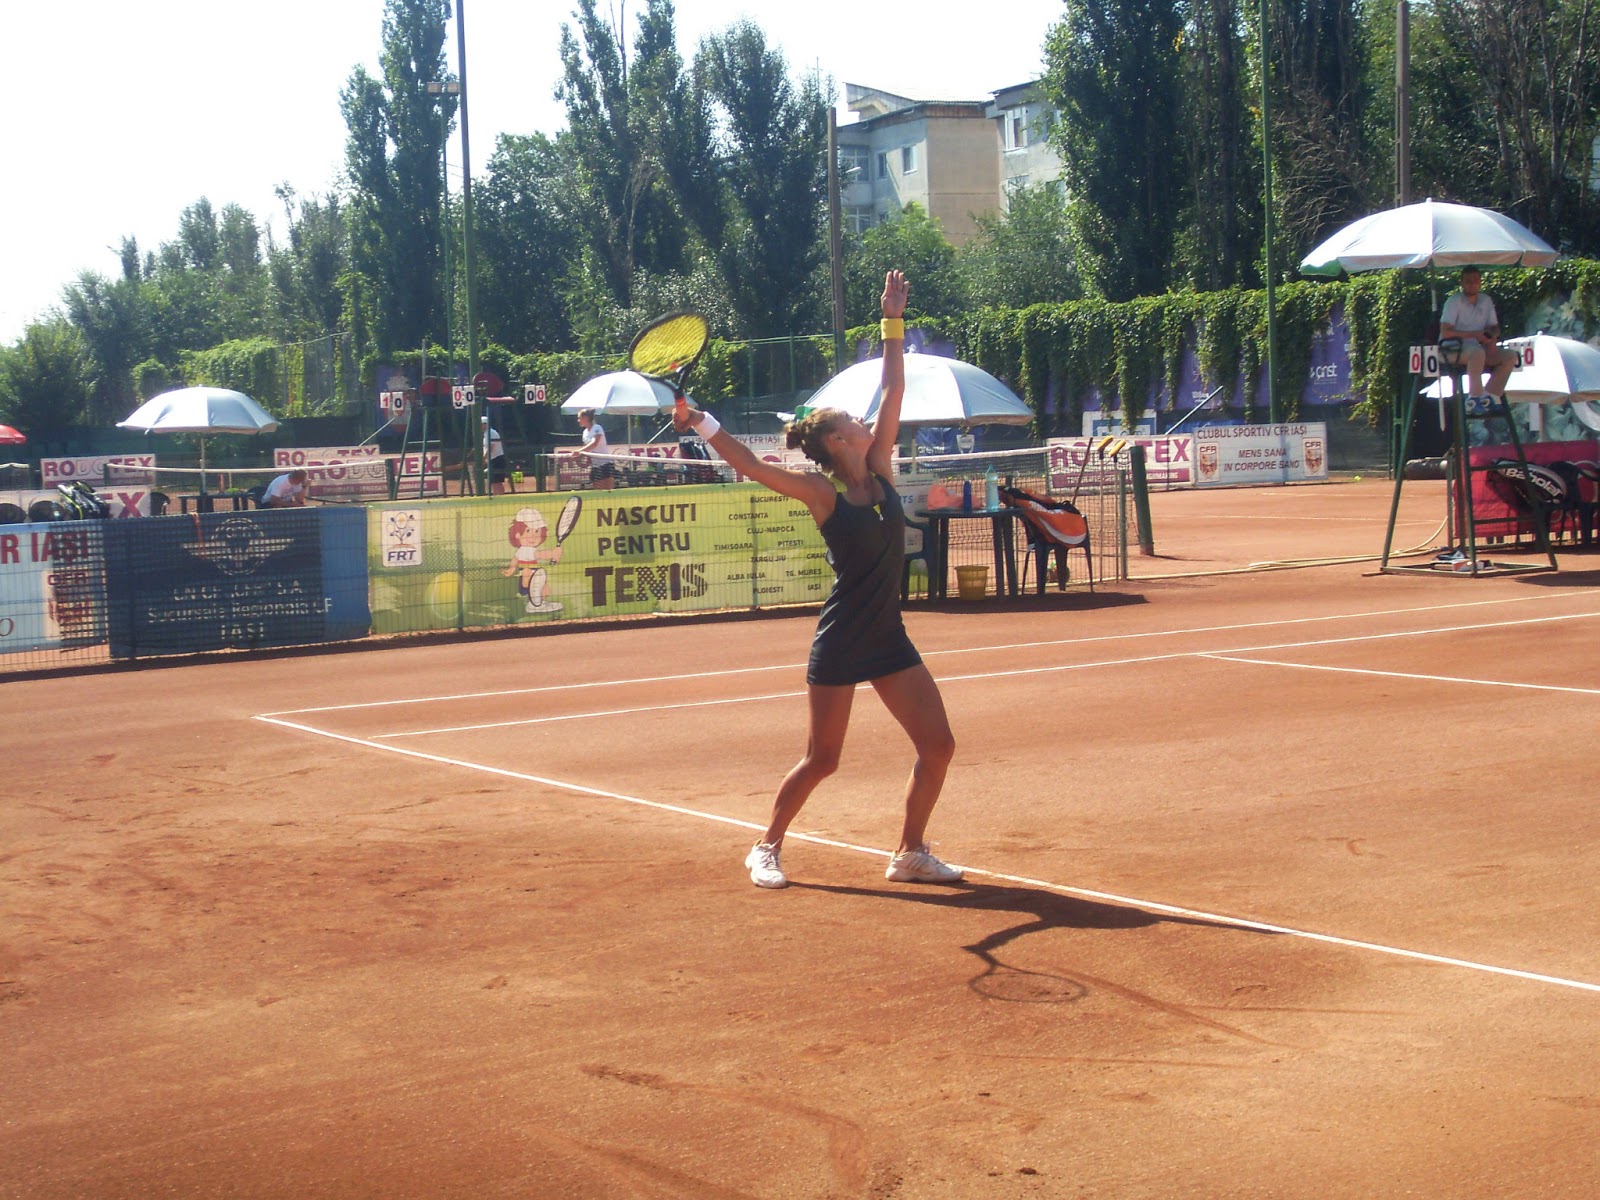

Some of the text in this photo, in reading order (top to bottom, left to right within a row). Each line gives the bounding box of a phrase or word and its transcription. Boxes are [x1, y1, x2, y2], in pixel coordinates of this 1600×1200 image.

[1524, 347, 1534, 365] 0
[1411, 353, 1437, 373] 0 0
[1197, 430, 1231, 439] CLUBUL
[1233, 427, 1271, 438] SPORTIV
[1274, 426, 1289, 436] CFR
[749, 436, 763, 444] CFR
[1238, 448, 1287, 458] MENS SANA
[1224, 460, 1300, 472] IN CORPORE SANO
[596, 502, 697, 528] NASCUTI
[728, 512, 769, 520] CONSTANTA
[746, 525, 795, 534] CLUJ-NAPOCA
[597, 531, 691, 556] PENTRU
[713, 539, 804, 551] TIMISOARA PITESTI
[387, 550, 417, 561] FRT
[798, 568, 822, 576] MURES
[584, 562, 708, 607] TENIS
[752, 586, 784, 594] PLOIESTI
